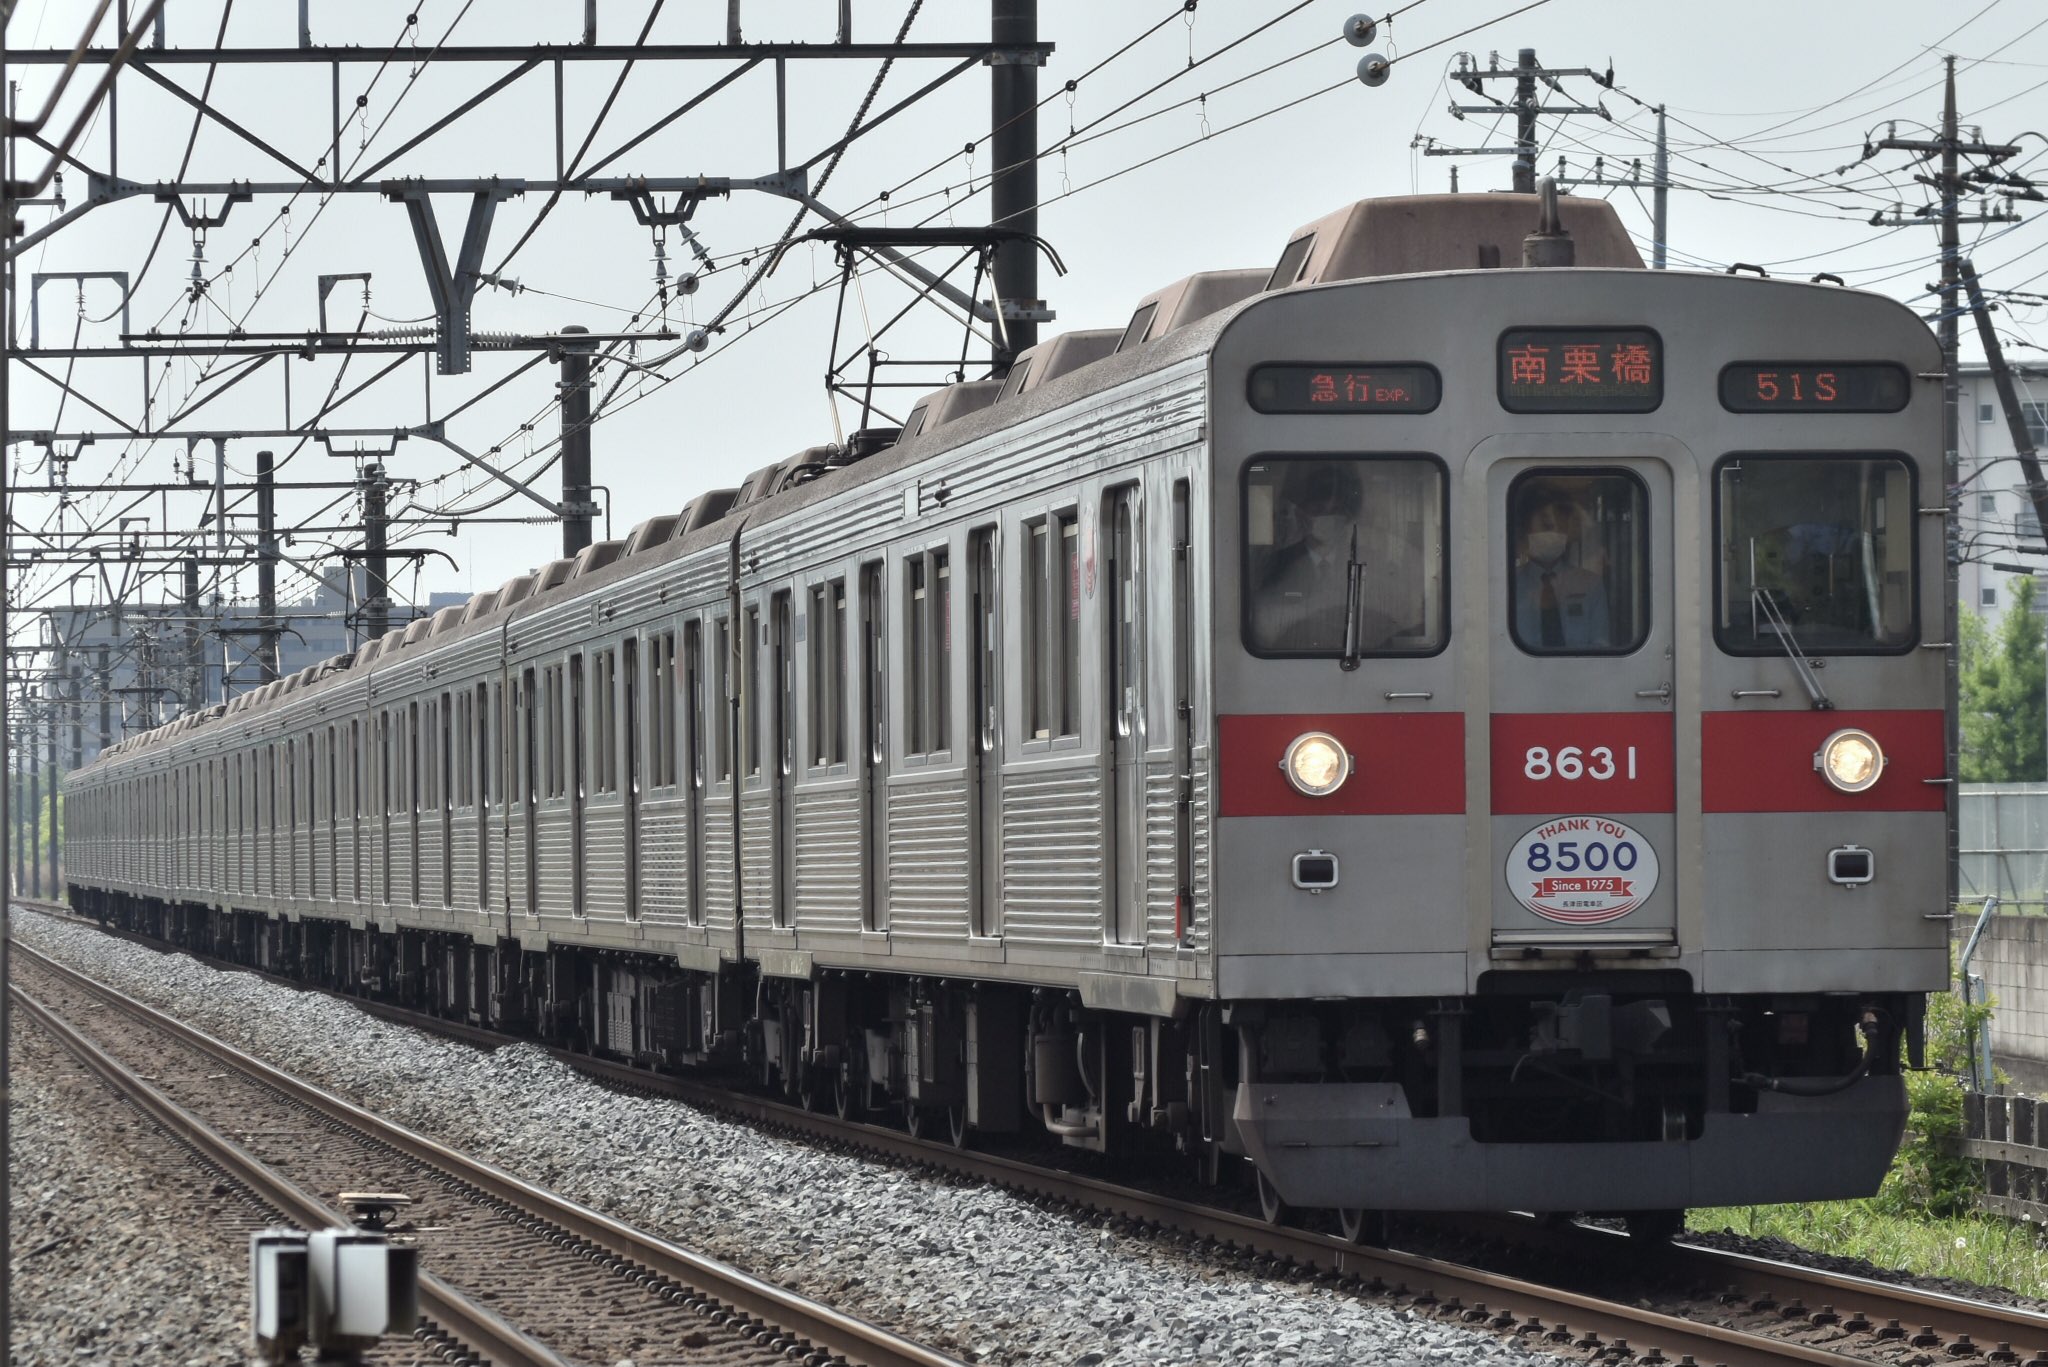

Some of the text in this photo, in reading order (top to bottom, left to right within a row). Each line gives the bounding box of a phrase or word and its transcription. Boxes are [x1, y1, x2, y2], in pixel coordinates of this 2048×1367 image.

[1507, 343, 1651, 385] 南栗橋
[1311, 373, 1372, 402] 急行
[1756, 372, 1838, 402] 51S
[1524, 745, 1637, 781] 8631
[1537, 818, 1627, 841] THANK YOU
[1527, 841, 1638, 873] 8500
[1551, 879, 1614, 891] Since 1975
